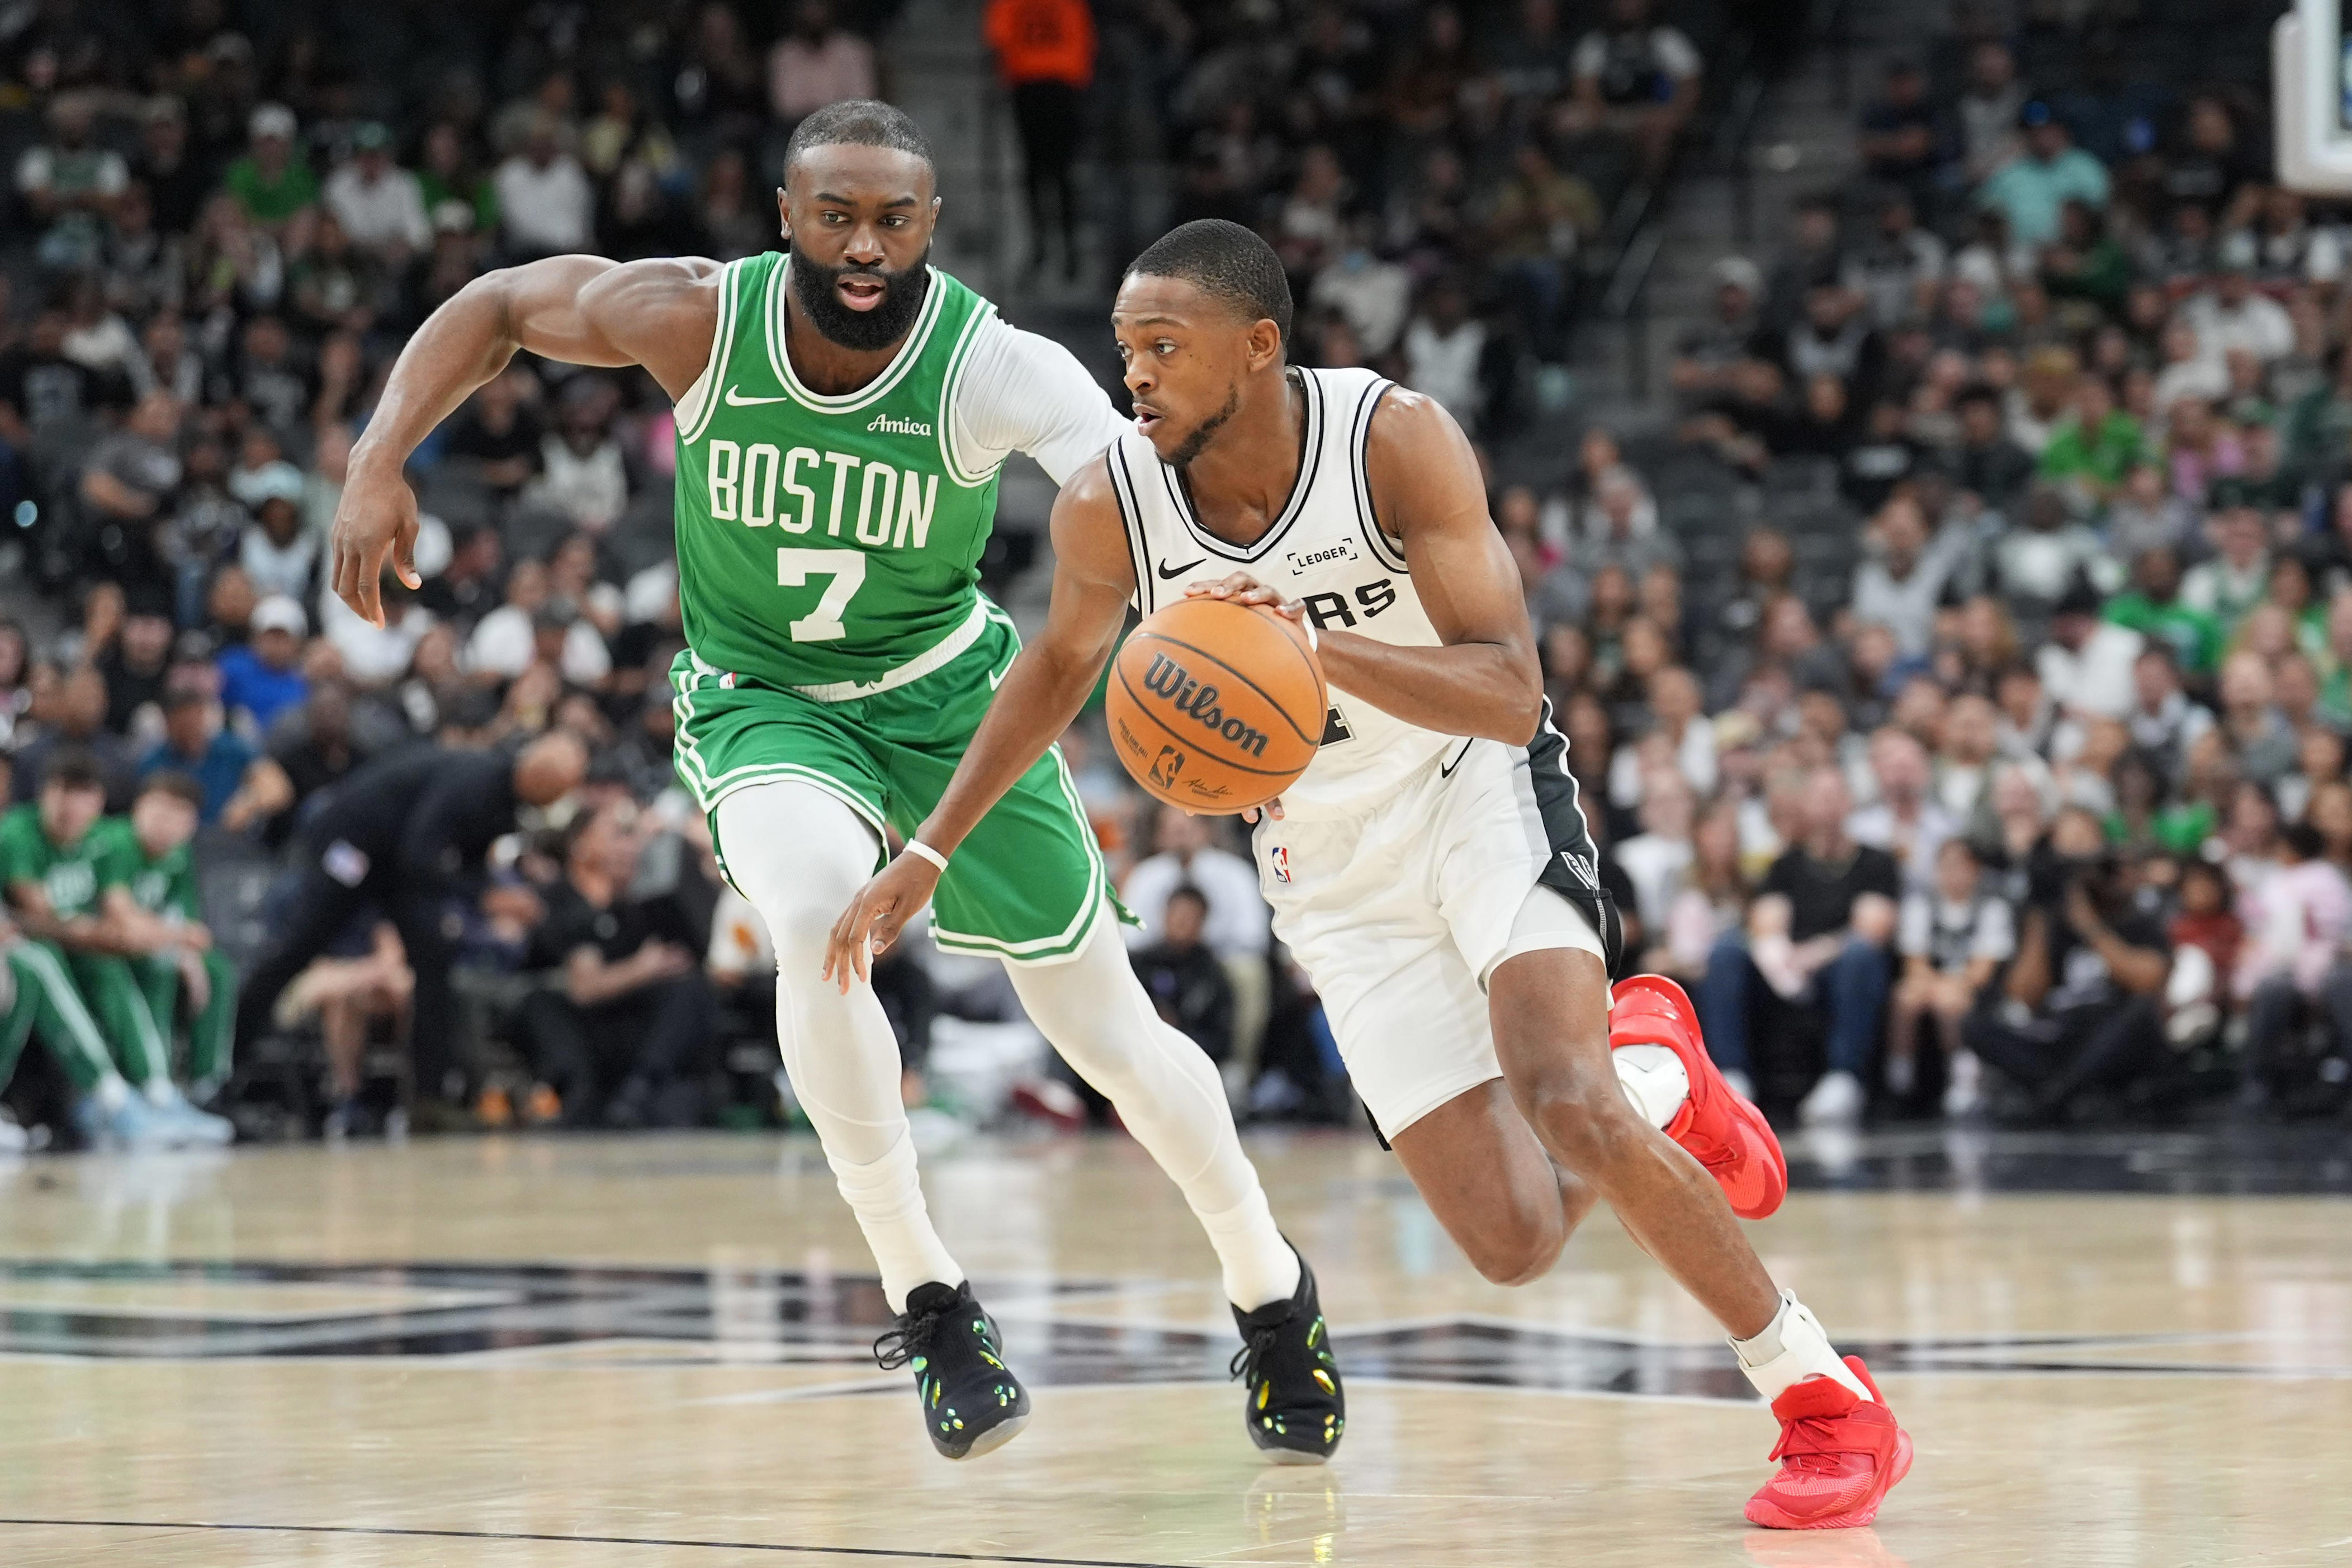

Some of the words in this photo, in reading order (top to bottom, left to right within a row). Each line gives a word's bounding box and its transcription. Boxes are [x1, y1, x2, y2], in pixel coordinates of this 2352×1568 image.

[867, 414, 931, 437] Amica
[707, 439, 939, 548] BOSTON
[777, 547, 866, 642] 7
[1297, 546, 1347, 567] LEDGER
[1143, 650, 1270, 759] Wilson
